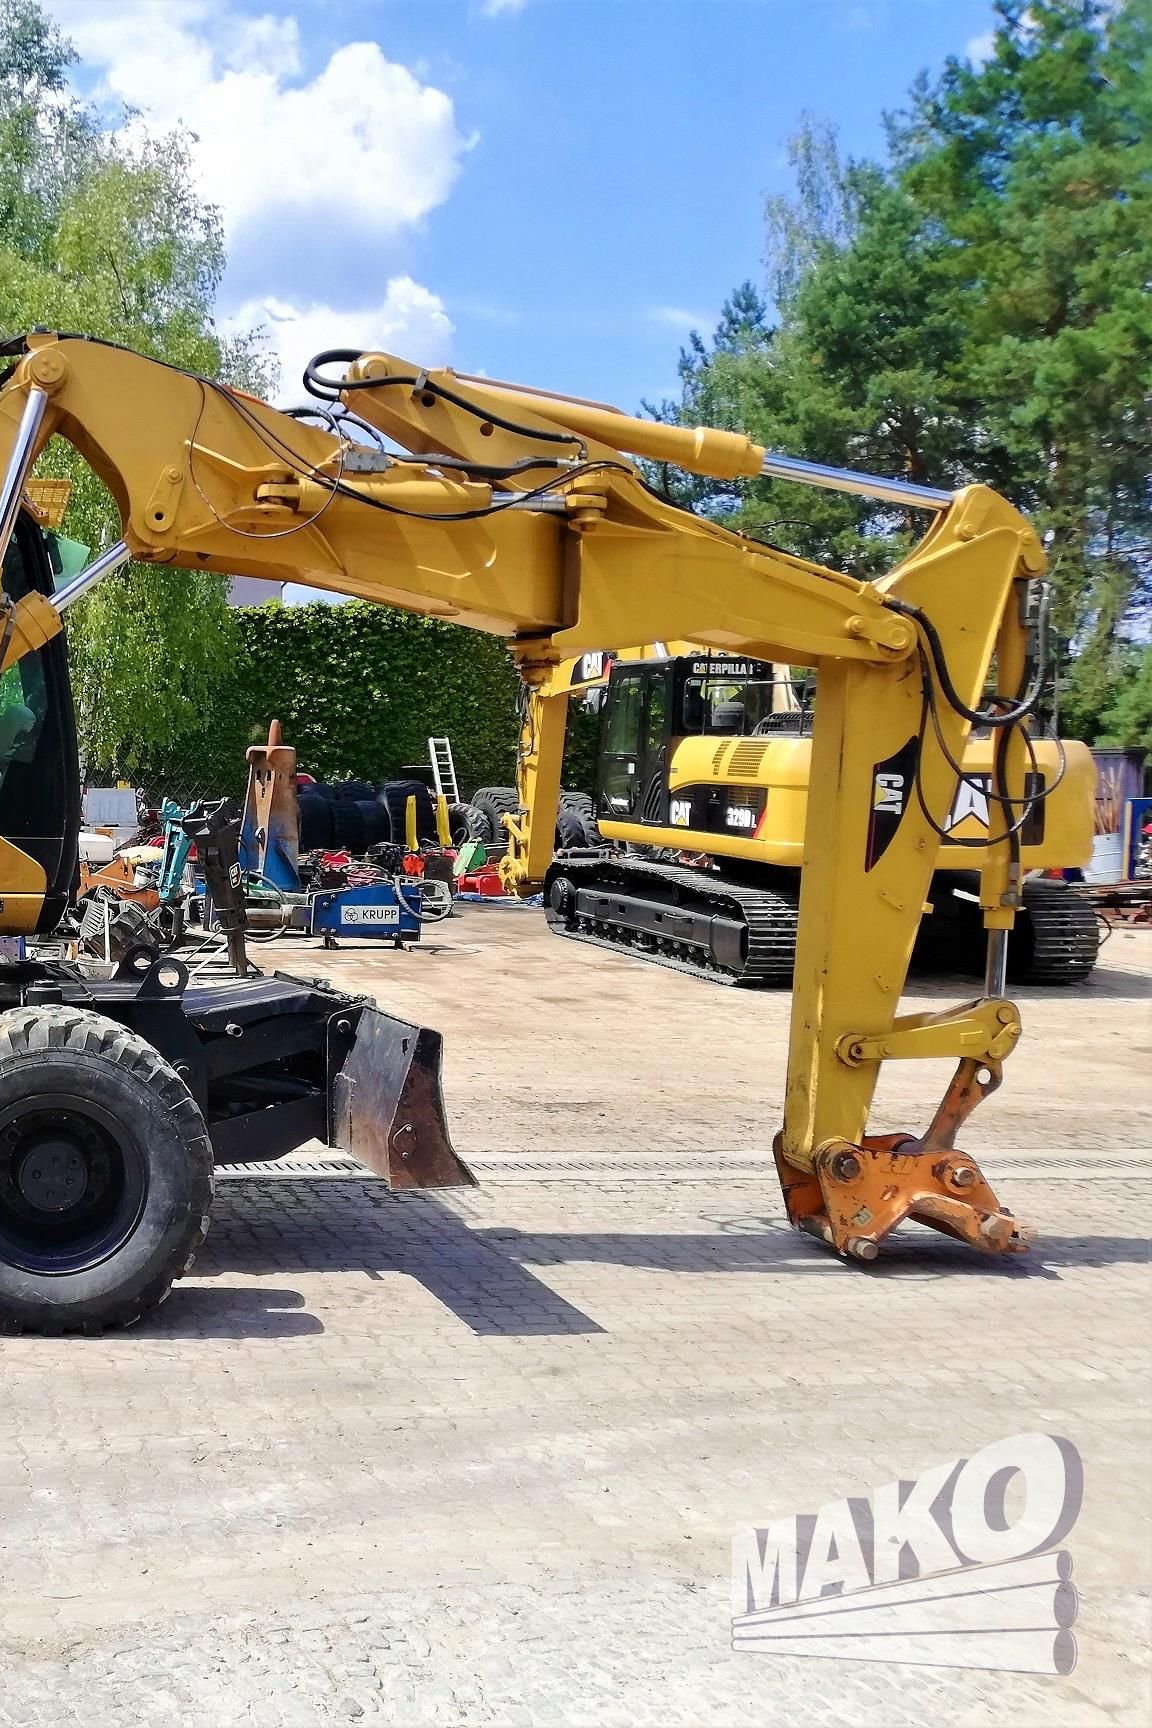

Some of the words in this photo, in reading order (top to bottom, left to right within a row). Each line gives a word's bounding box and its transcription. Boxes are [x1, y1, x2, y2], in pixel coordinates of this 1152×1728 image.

[583, 652, 603, 679] CAT
[874, 774, 904, 814] CAT
[671, 800, 692, 826] CAT
[362, 909, 397, 920] KRUPP
